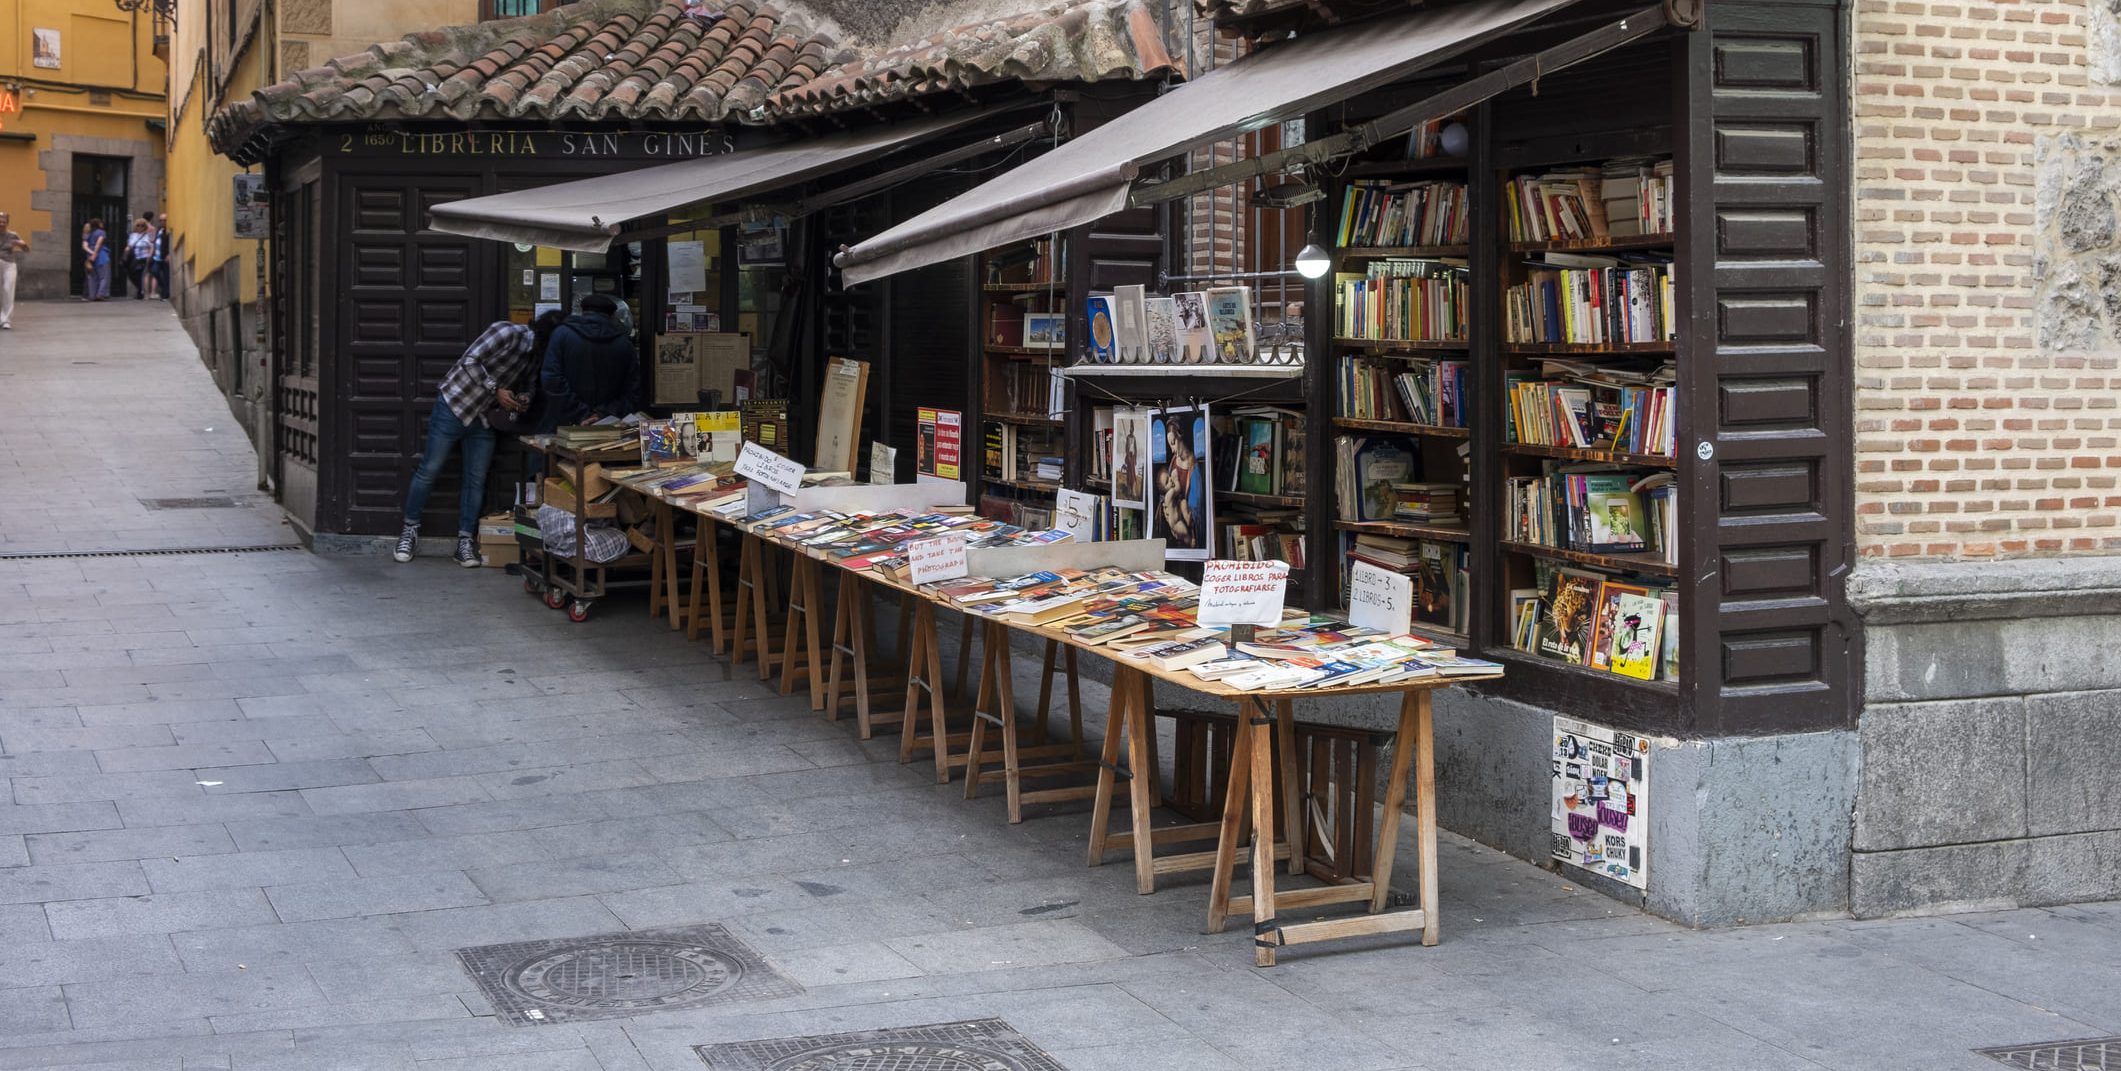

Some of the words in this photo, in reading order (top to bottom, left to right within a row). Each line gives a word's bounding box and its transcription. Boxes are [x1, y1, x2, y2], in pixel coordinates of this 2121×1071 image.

[340, 133, 353, 153] 2
[363, 134, 395, 146] 1650
[562, 134, 618, 155] SAN
[1206, 560, 1274, 571] PROHIBIDO
[1204, 574, 1231, 583] COGER
[1234, 573, 1264, 582] LIBROS
[1268, 572, 1289, 582] PARA
[1605, 835, 1626, 848] KORS
[1606, 847, 1626, 860] CHUKY
